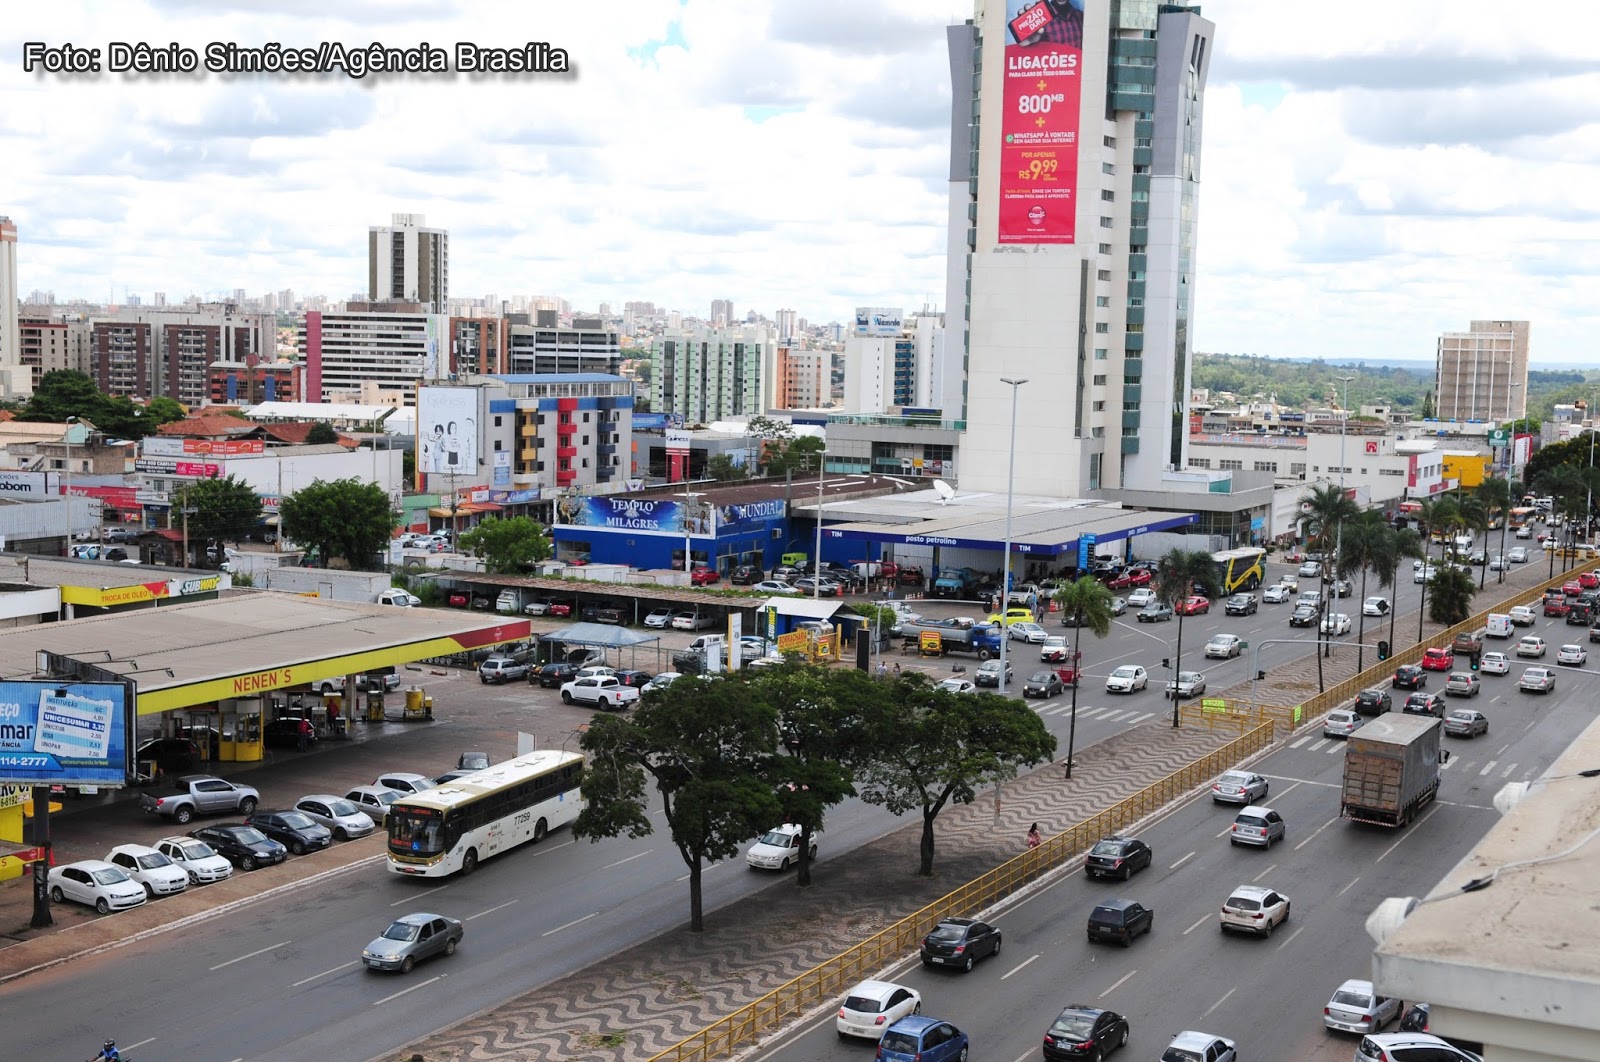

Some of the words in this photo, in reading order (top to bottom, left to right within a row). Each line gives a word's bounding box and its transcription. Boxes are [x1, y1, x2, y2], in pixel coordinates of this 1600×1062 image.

[1029, 16, 1047, 31] DURA
[1009, 51, 1077, 71] LIGAÇÕES
[612, 499, 654, 512] TEMPLO
[739, 501, 779, 519] MUNDIAL
[606, 516, 658, 529] MILAGRES
[906, 535, 924, 543] posto
[926, 536, 957, 545] petrolino
[1019, 544, 1030, 552] TIM
[181, 576, 221, 596] SUBWAY
[132, 590, 148, 599] ÓLEO
[46, 697, 78, 708] INSTITUIÇÃO
[44, 713, 90, 728] UNICESUMAR
[0, 724, 33, 739] mar
[514, 812, 531, 827] 77259
